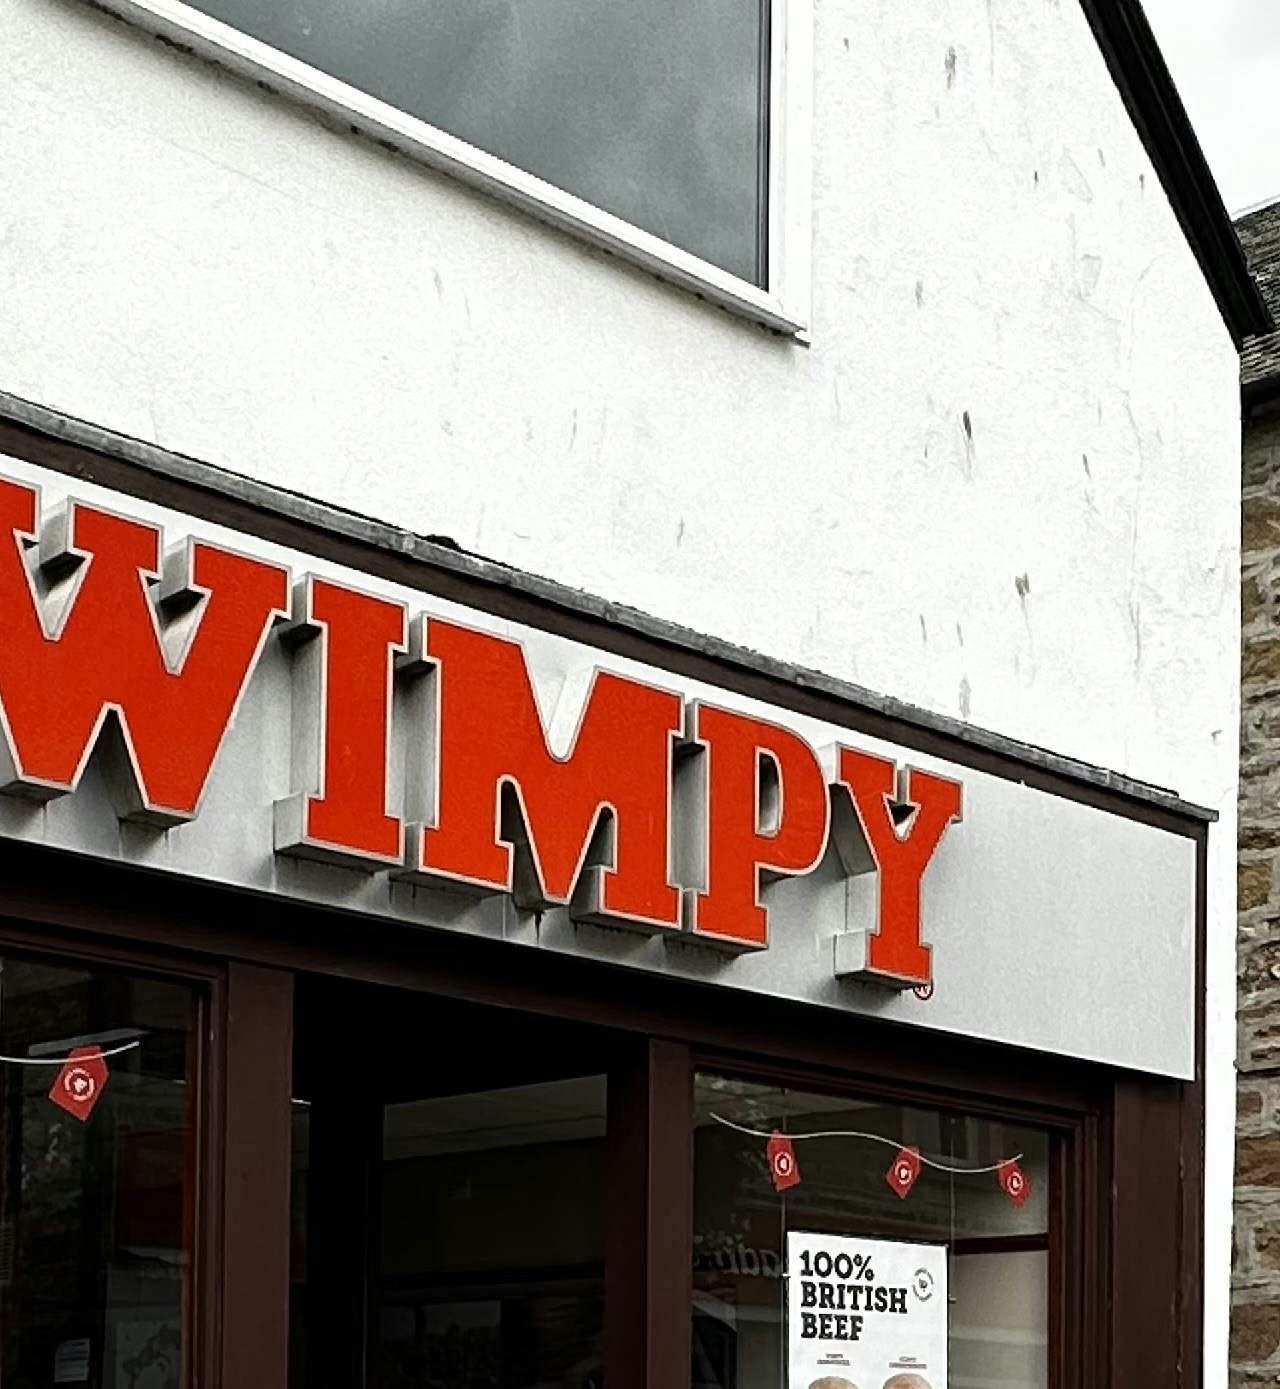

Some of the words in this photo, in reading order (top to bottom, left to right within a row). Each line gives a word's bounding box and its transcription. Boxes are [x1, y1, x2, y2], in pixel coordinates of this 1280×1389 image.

[799, 1250, 874, 1281] 100%
[800, 1281, 908, 1314] BRITISH
[800, 1312, 863, 1341] BEEF
